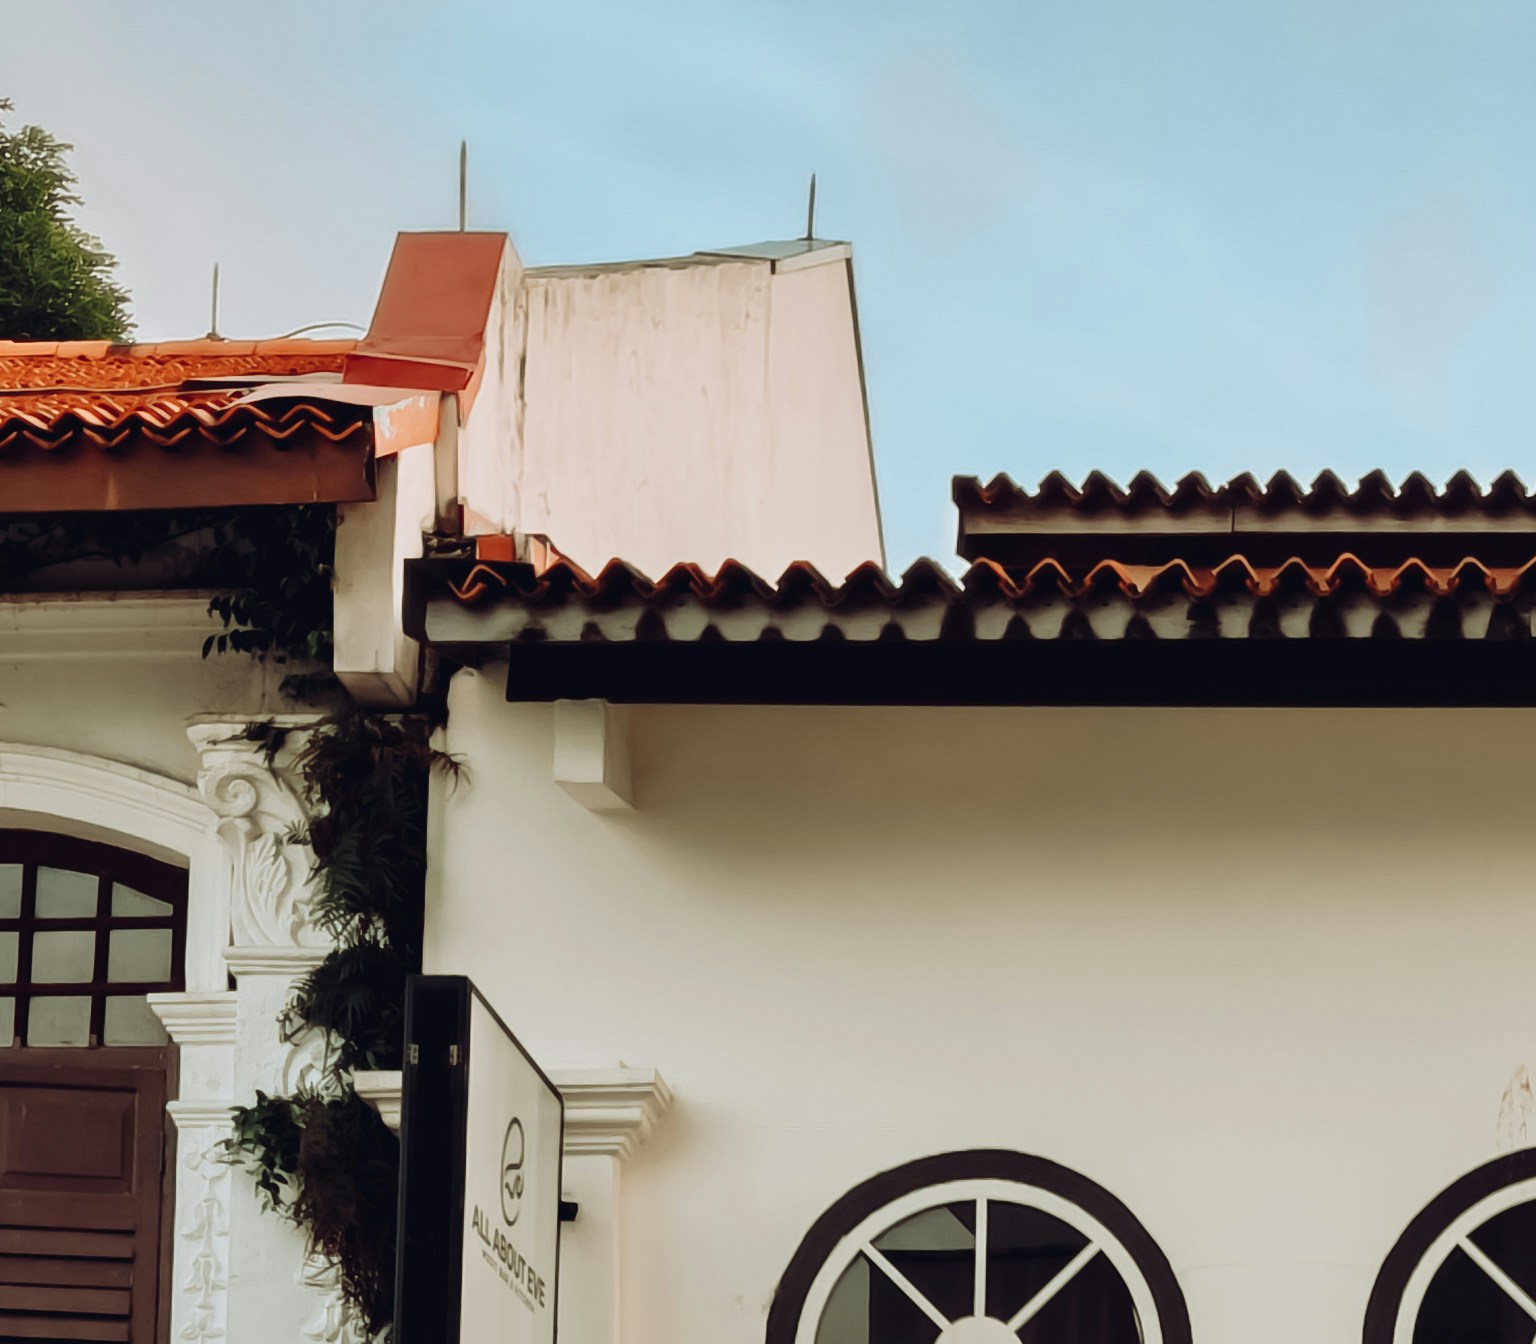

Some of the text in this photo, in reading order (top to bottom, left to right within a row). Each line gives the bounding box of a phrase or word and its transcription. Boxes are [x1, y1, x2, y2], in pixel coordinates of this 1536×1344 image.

[472, 1205, 545, 1308] ALL ABOUT EVE
